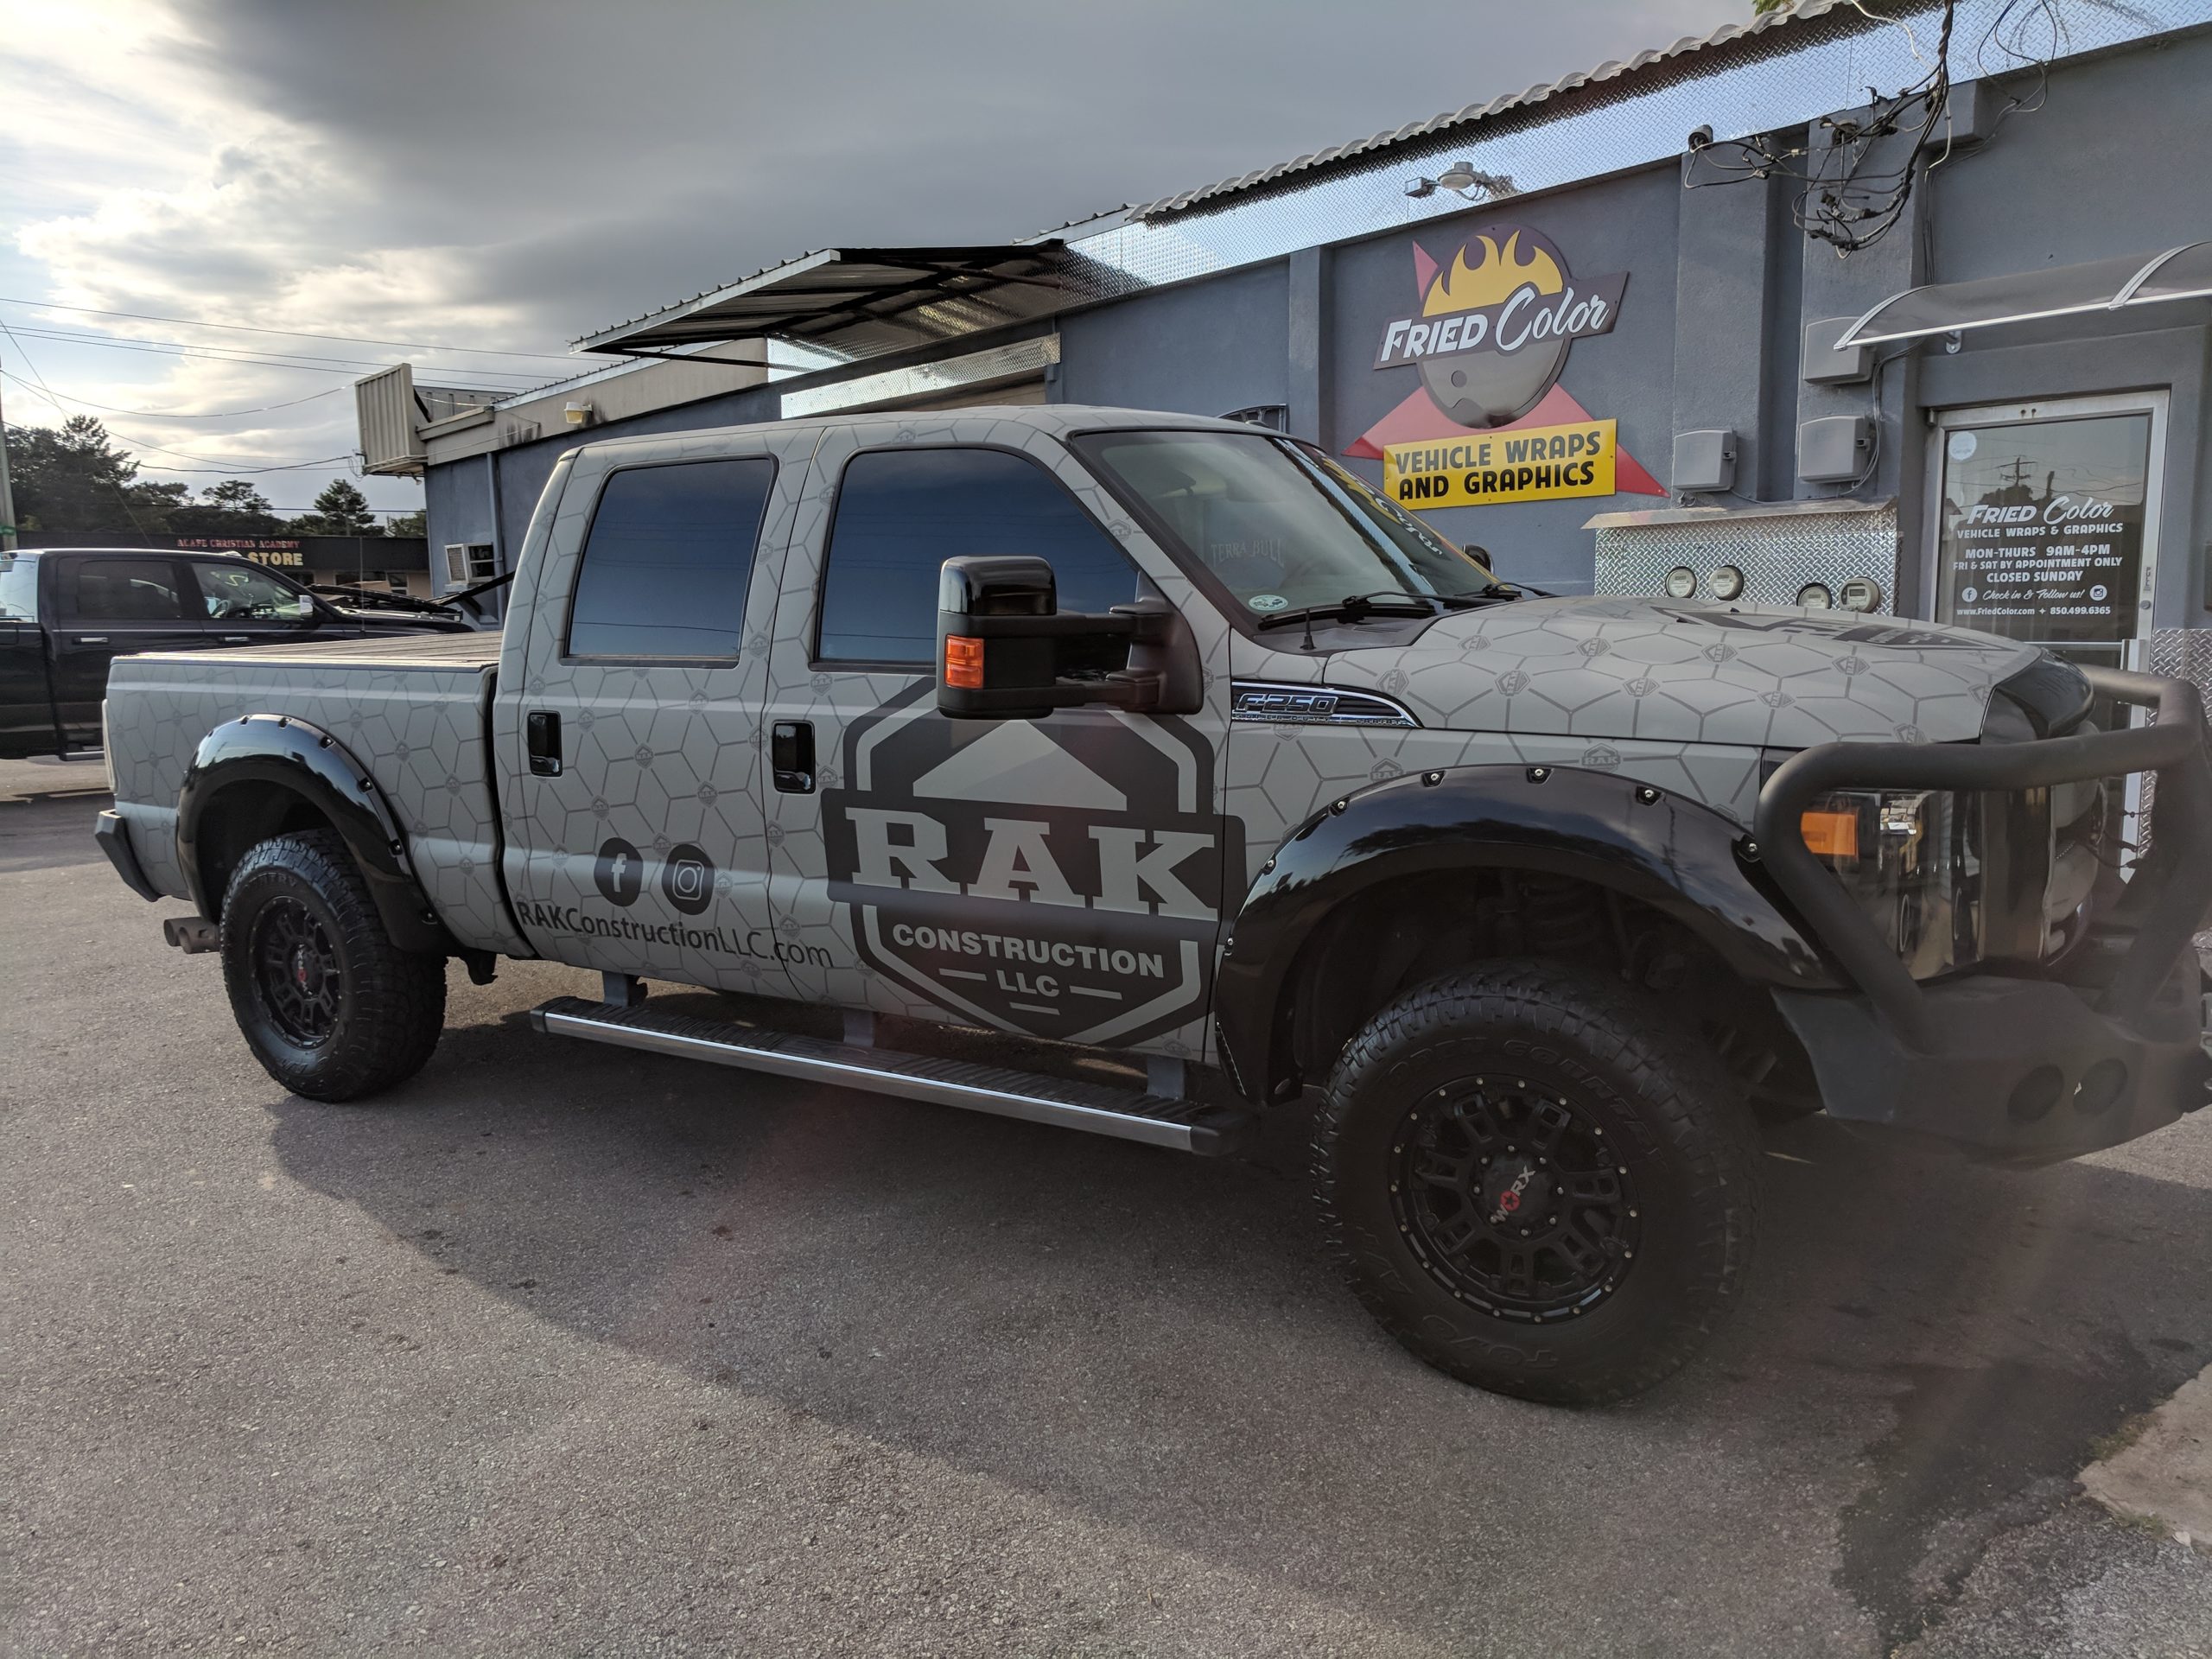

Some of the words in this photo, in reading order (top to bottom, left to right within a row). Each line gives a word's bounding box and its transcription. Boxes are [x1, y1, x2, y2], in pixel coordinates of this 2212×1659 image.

[1380, 314, 1488, 361] FRIED
[1495, 286, 1610, 351] Color
[1395, 443, 1491, 474] VEHICLE
[1505, 431, 1601, 463] WRAPS
[1399, 475, 1449, 500] AND
[1464, 461, 1594, 493] GRAPHICS
[1967, 505, 2037, 524] FRIED
[2043, 496, 2114, 525] Color
[1957, 528, 2000, 539] VEHICLE
[2005, 526, 2046, 537] WRAPS
[2050, 526, 2059, 535] &
[2063, 523, 2123, 534] GRAPHICS
[210, 539, 255, 548] CHRISTIAN
[259, 539, 300, 548] ACADEMY
[1965, 547, 2037, 559] MON-THURS
[2046, 544, 2111, 556] 9AM-4PM
[247, 551, 303, 566] STORE
[1953, 562, 1969, 570] FRI
[1970, 561, 1977, 570] &
[1980, 561, 1998, 569] SAT
[1999, 560, 2012, 569] BY
[2015, 558, 2090, 569] APPOINTMENT
[2094, 556, 2123, 568] ONLY
[1986, 571, 2031, 583] CLOSED
[2033, 570, 2084, 582] SUNDAY
[1982, 589, 2009, 601] Check
[2011, 590, 2021, 600] in
[2023, 589, 2032, 600] &
[2036, 588, 2069, 601] Follow
[2069, 588, 2085, 599] us!
[1956, 607, 2035, 616] www.FriedColor.com
[2050, 606, 2111, 616] 850.499.6365
[1236, 694, 1338, 715] F-250
[1584, 755, 1618, 765] RAK
[845, 807, 1218, 922] RAK
[517, 901, 834, 968] RAKConstructionLLC.com
[892, 923, 1165, 979] CONSTRUCTION
[996, 969, 1060, 998] LLC
